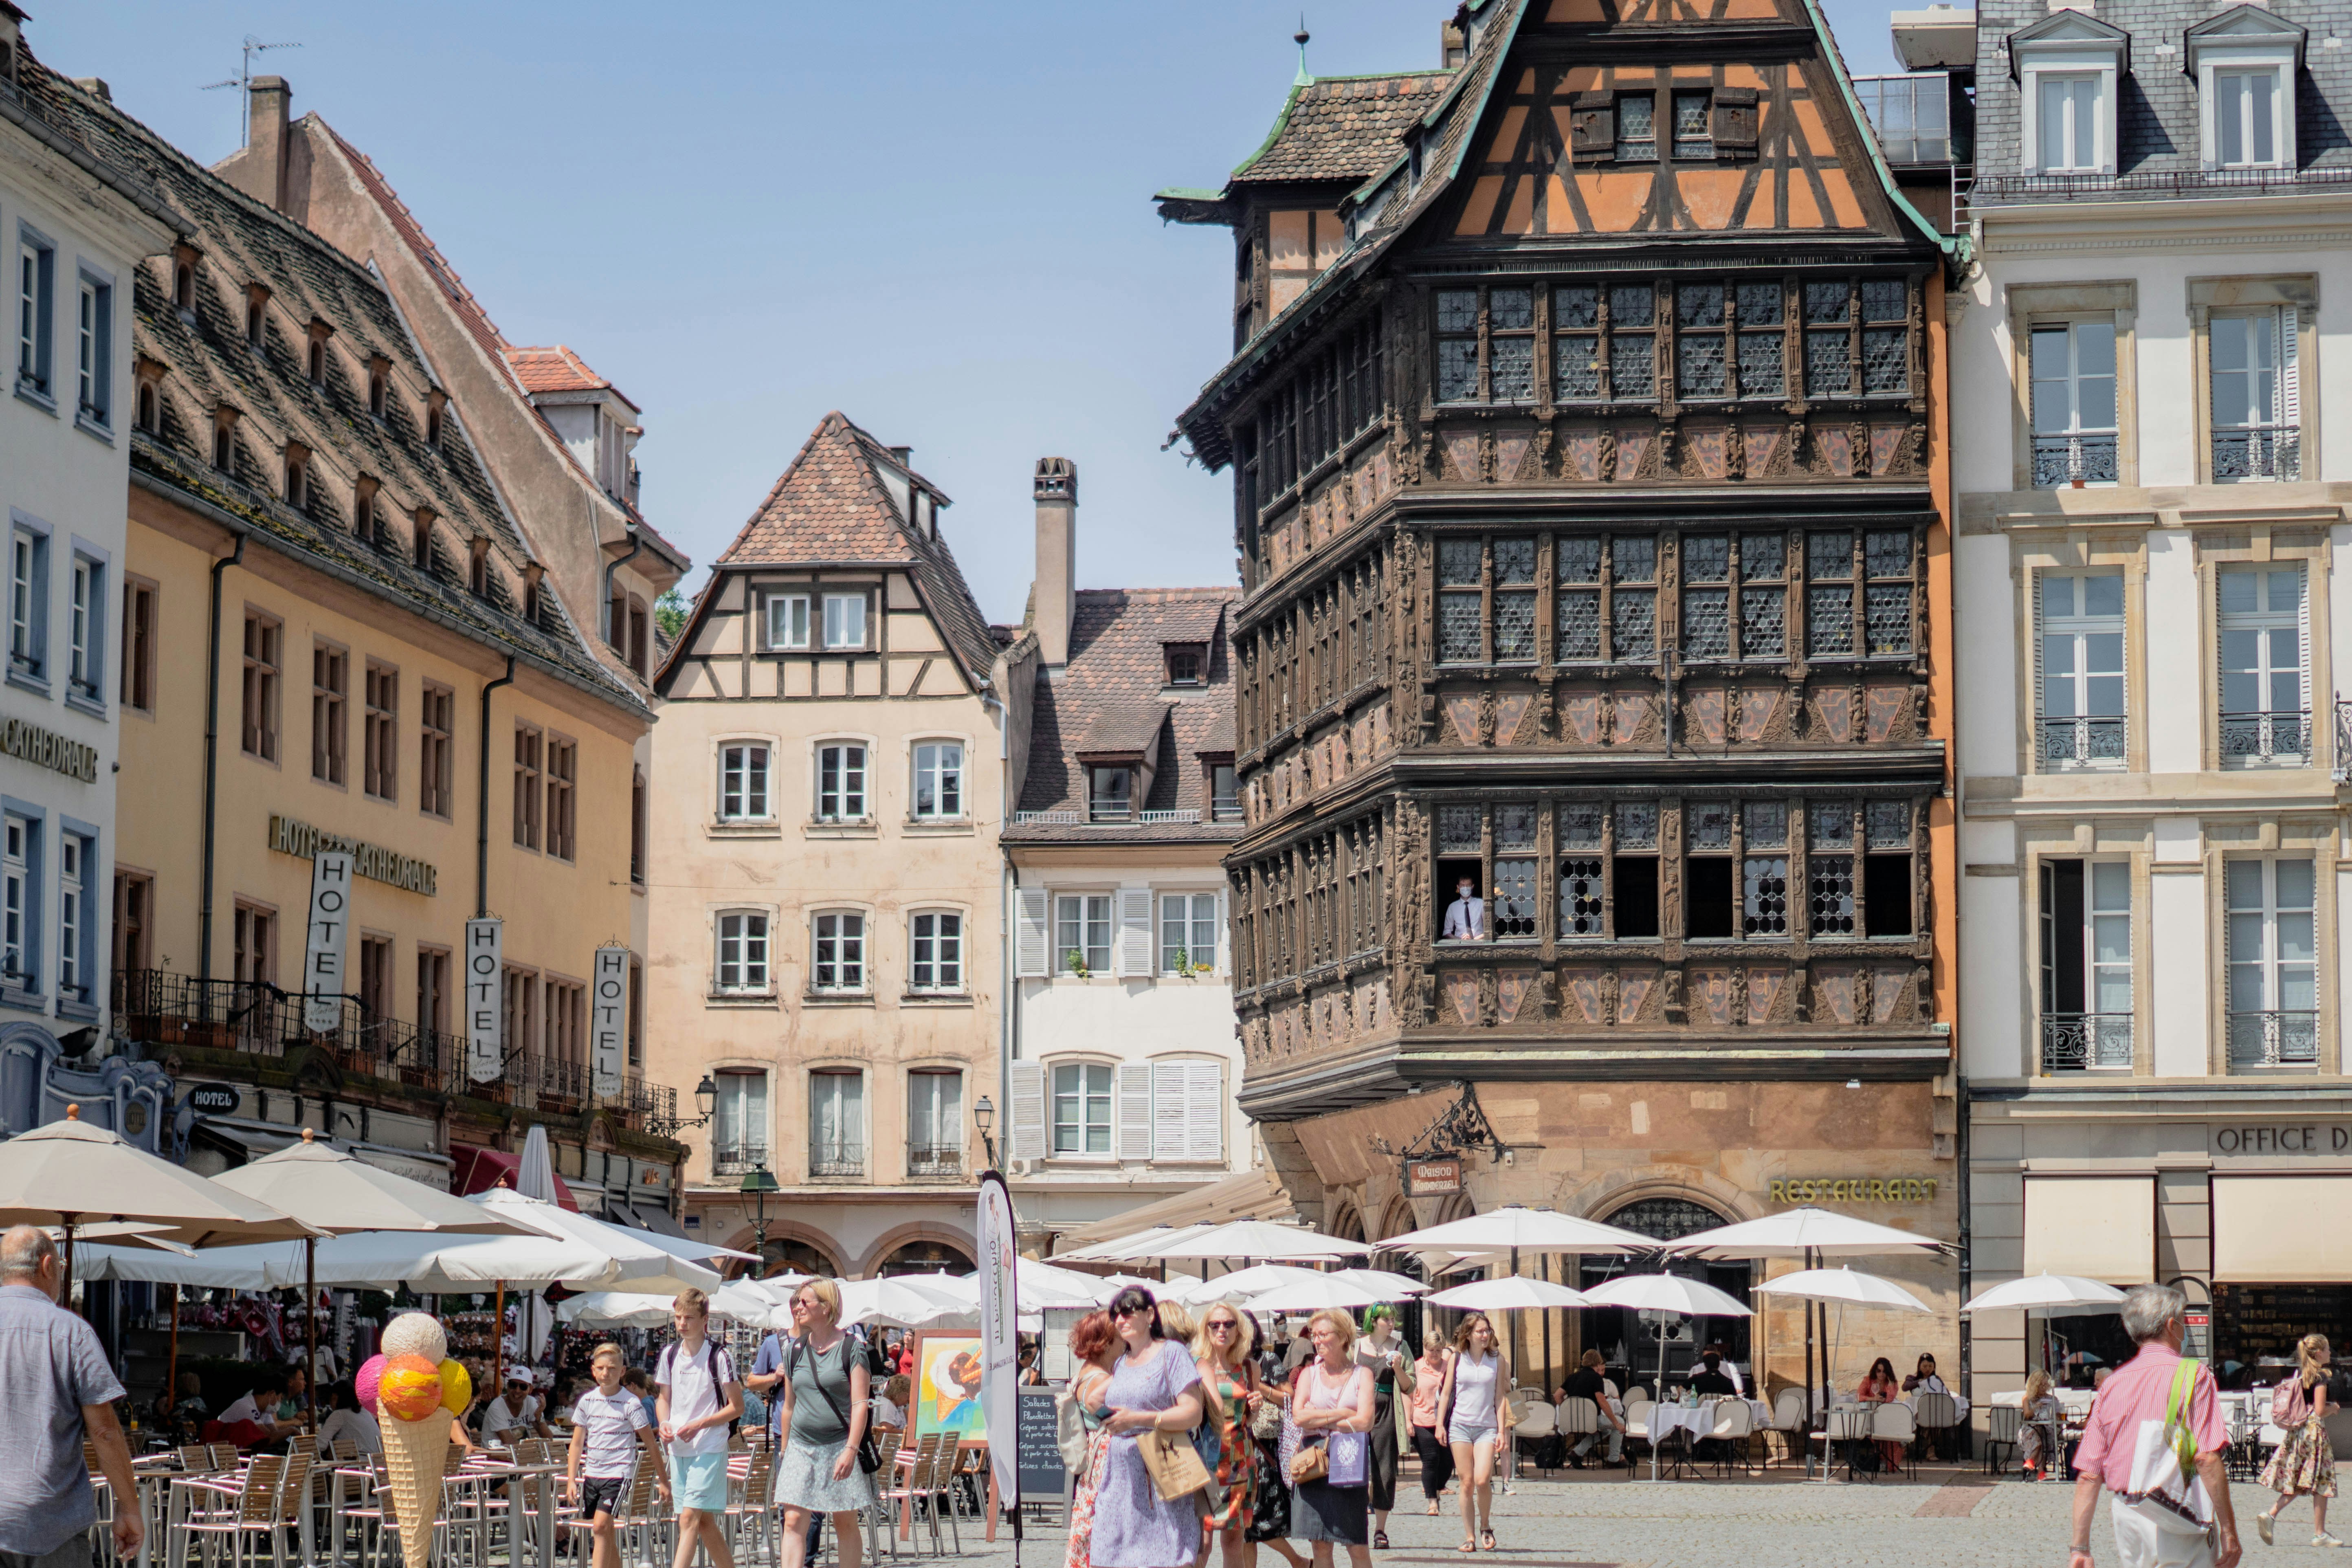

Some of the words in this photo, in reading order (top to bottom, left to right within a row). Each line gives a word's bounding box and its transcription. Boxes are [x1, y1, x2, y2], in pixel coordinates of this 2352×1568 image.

[4, 718, 98, 782] CATHEDRALE
[353, 842, 437, 896] CATHEDRALE
[314, 860, 344, 1005] HOTEL
[473, 928, 495, 1058] HOTEL
[600, 955, 621, 1075] HOTEL
[195, 1091, 232, 1106] HOTEL
[2217, 1127, 2317, 1151] OFFICE
[2331, 1127, 2352, 1150] D
[1769, 1179, 1938, 1204] RESTAURANT
[251, 1410, 260, 1420] 3
[1022, 1396, 1051, 1407] Salades
